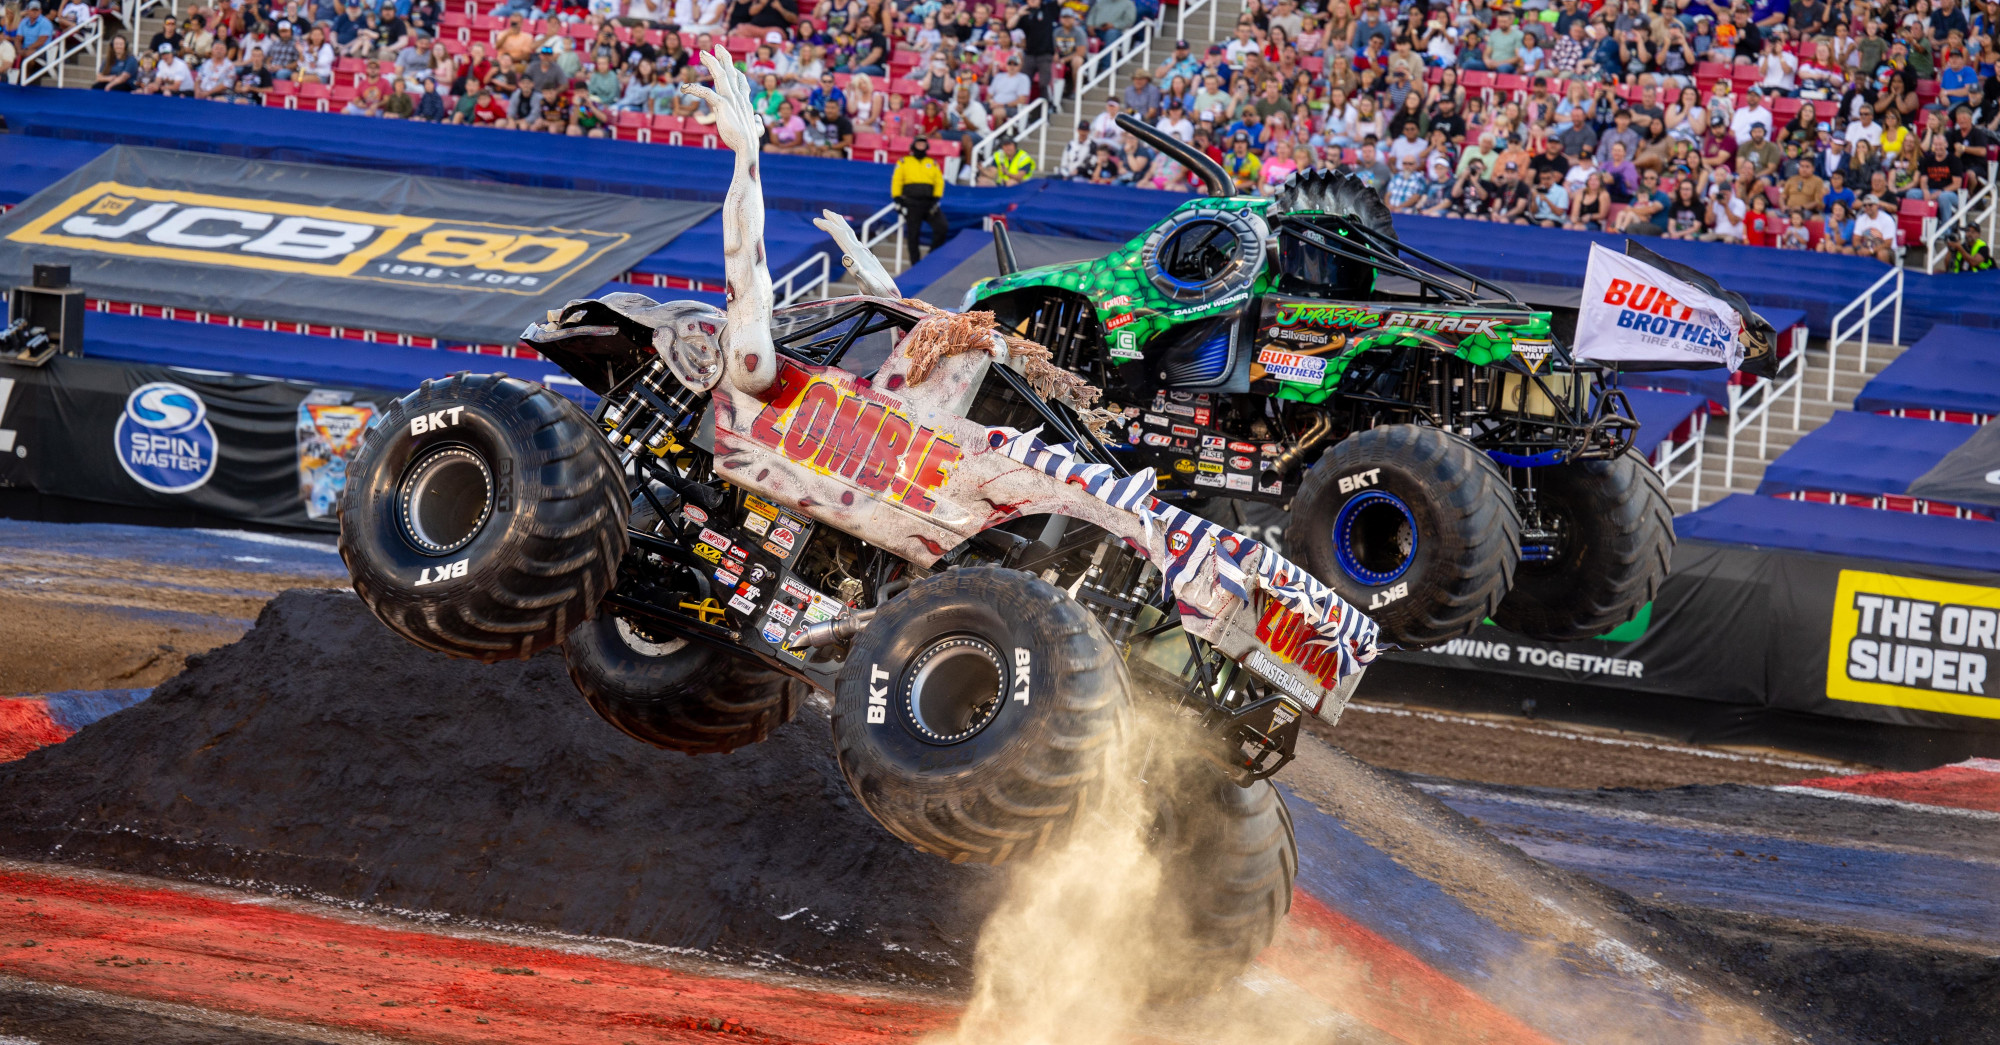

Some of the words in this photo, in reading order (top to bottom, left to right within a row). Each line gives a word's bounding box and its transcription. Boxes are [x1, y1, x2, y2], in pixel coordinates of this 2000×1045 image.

[62, 203, 375, 259] JCB
[397, 230, 589, 274] 80
[1174, 303, 1212, 316] DALTON
[1213, 293, 1249, 307] WIDNER
[1603, 278, 1694, 321] BURT
[1107, 314, 1131, 328] GARAGE
[1276, 303, 1381, 328] JURASSIC
[1383, 313, 1504, 339] ATTACK
[1280, 329, 1328, 344] Silverleaf
[1641, 333, 1669, 348] TIRE
[1259, 351, 1304, 367] BURT
[1524, 352, 1544, 360] JAM
[1266, 363, 1324, 379] BROTHERS
[410, 405, 464, 437] BKT
[131, 432, 199, 458] SPIN
[751, 361, 963, 515] ZOMBIE
[1204, 437, 1222, 446] JE
[1338, 468, 1381, 494] BKT
[702, 530, 728, 548] SIMPSON
[774, 529, 793, 544] JAZ
[731, 546, 747, 558] Coan
[414, 558, 469, 587] BKT
[786, 578, 811, 596] LINCOLN
[1368, 581, 1408, 610] BKT
[774, 604, 794, 618] FK
[1857, 595, 1935, 642] THE
[1516, 646, 1644, 679] TOGETHER
[1849, 638, 1987, 694] SUPER
[1014, 647, 1031, 706] BKT
[867, 664, 890, 724] BKT
